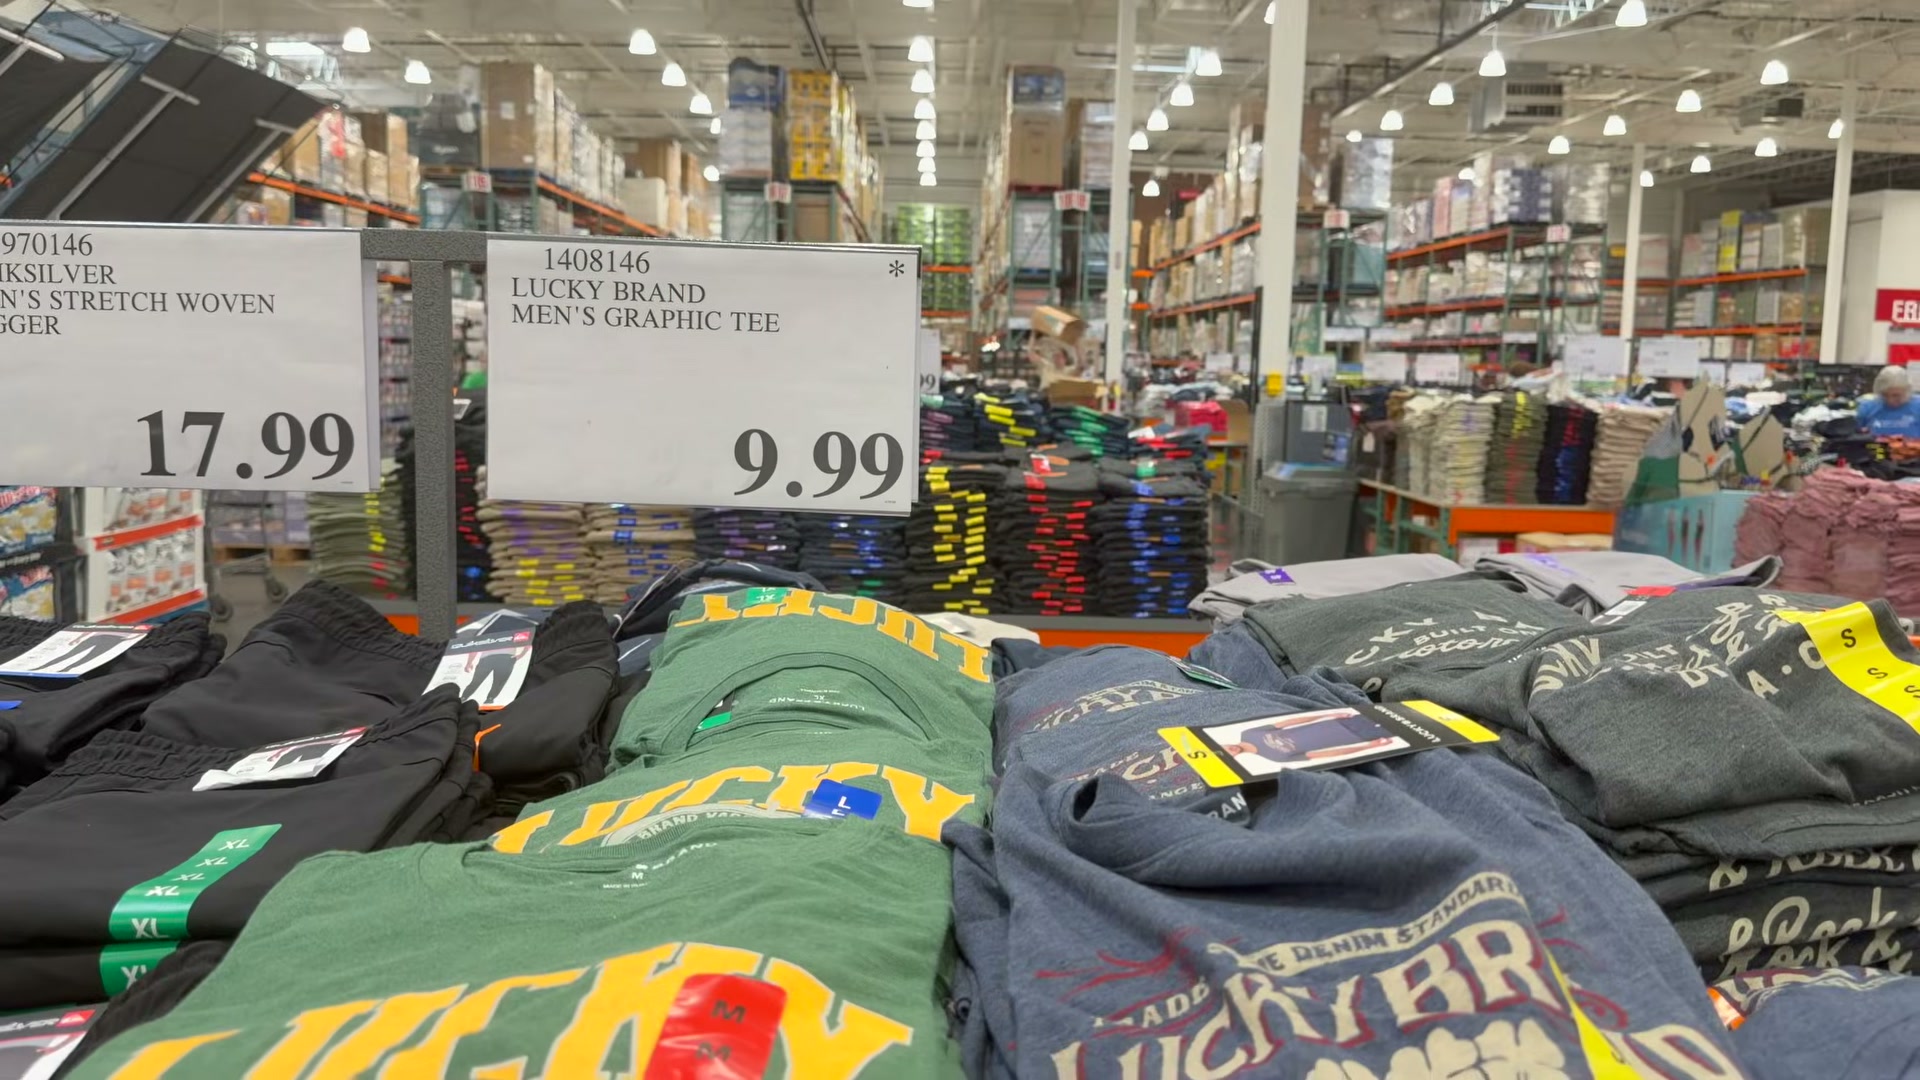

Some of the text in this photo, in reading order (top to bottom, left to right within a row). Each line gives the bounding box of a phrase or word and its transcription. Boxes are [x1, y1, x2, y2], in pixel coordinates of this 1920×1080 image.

[2, 233, 93, 256] 970146
[543, 247, 651, 274] 1408146
[511, 277, 706, 303] LUCKY BRAND
[50, 291, 167, 312] STRETCH
[177, 293, 276, 314] WOVEN
[511, 304, 781, 333] MEN'S GRAPHIC TEE
[137, 409, 355, 480] 17.99
[733, 428, 904, 500] 9.99
[1841, 628, 1857, 648] S
[1867, 667, 1888, 680] S
[1187, 750, 1207, 760] S
[838, 796, 851, 809] L
[637, 813, 699, 840] BRAND
[217, 838, 250, 851] XL
[195, 856, 228, 867] XL
[171, 873, 205, 881] XL
[631, 872, 645, 881] M
[144, 886, 180, 897] XL
[131, 917, 170, 939] XL
[1292, 932, 1388, 960] DENIM
[710, 1000, 747, 1024] M
